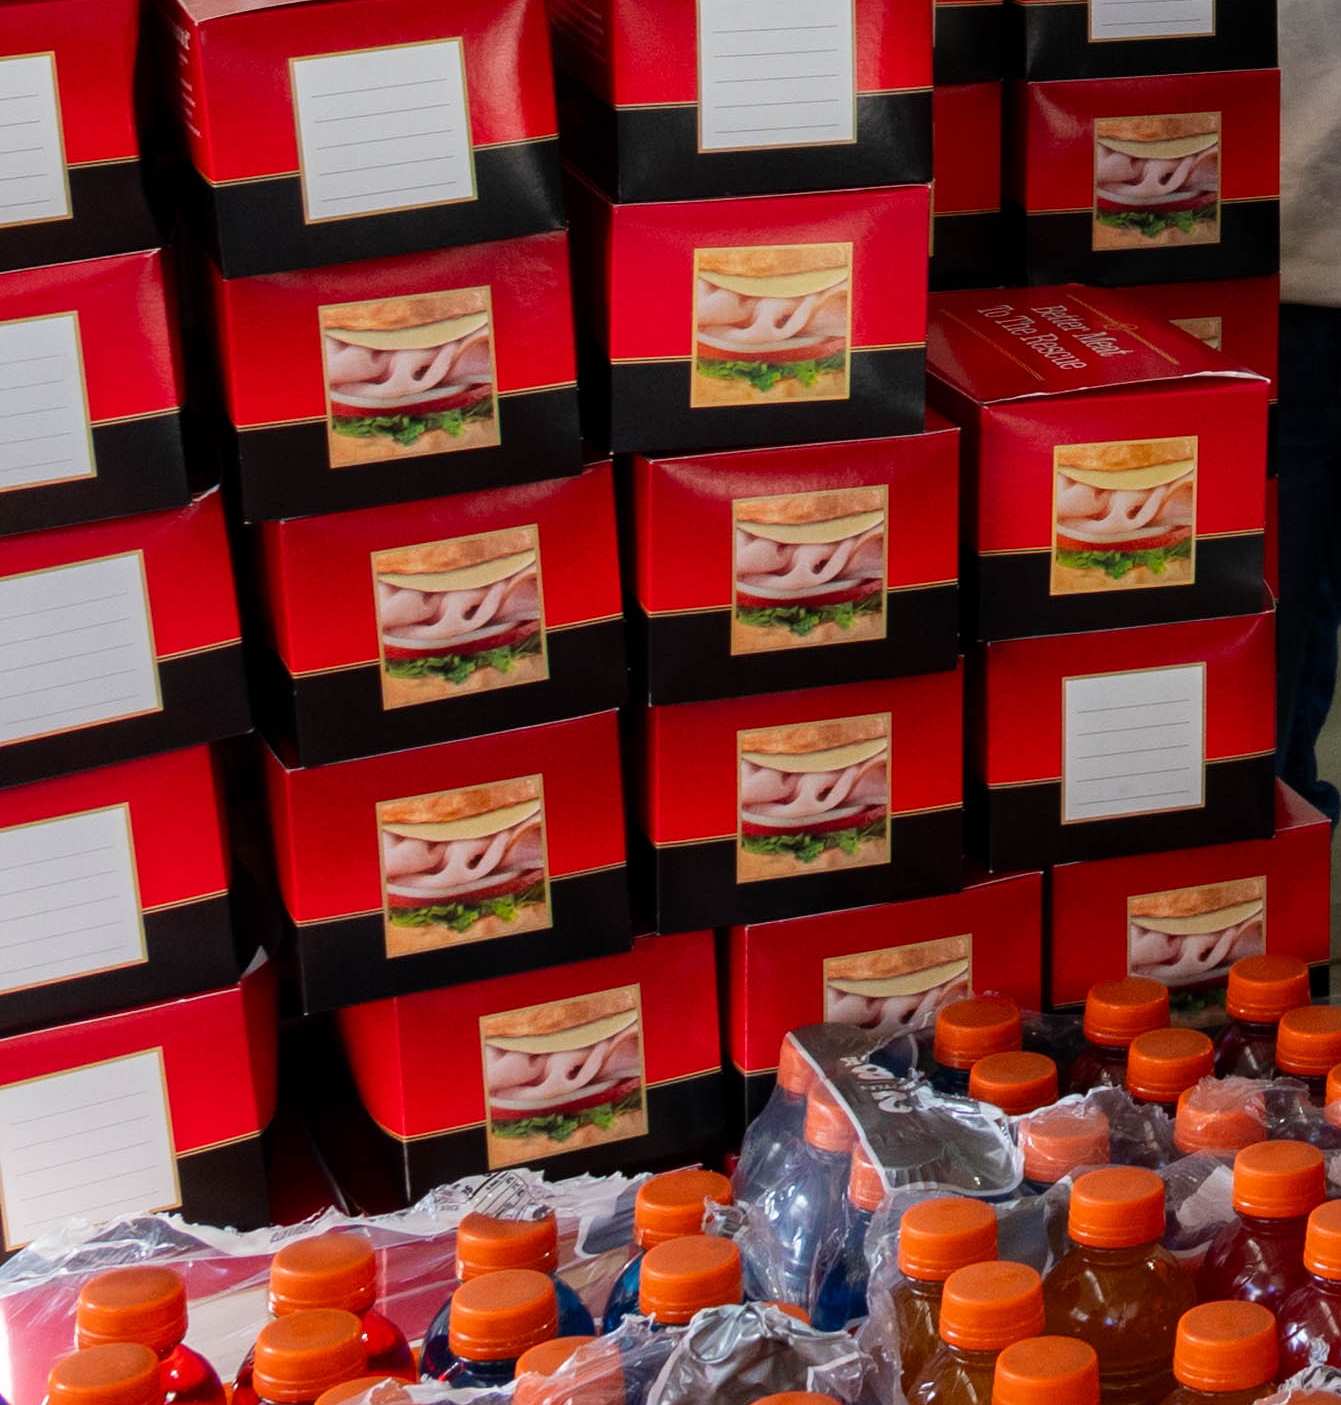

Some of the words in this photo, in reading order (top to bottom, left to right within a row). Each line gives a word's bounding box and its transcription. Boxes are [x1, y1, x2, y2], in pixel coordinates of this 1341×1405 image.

[977, 304, 1011, 322] To
[999, 313, 1036, 338] The
[1019, 332, 1087, 372] Rescue
[1030, 304, 1082, 332] Better
[1072, 330, 1134, 357] Meat
